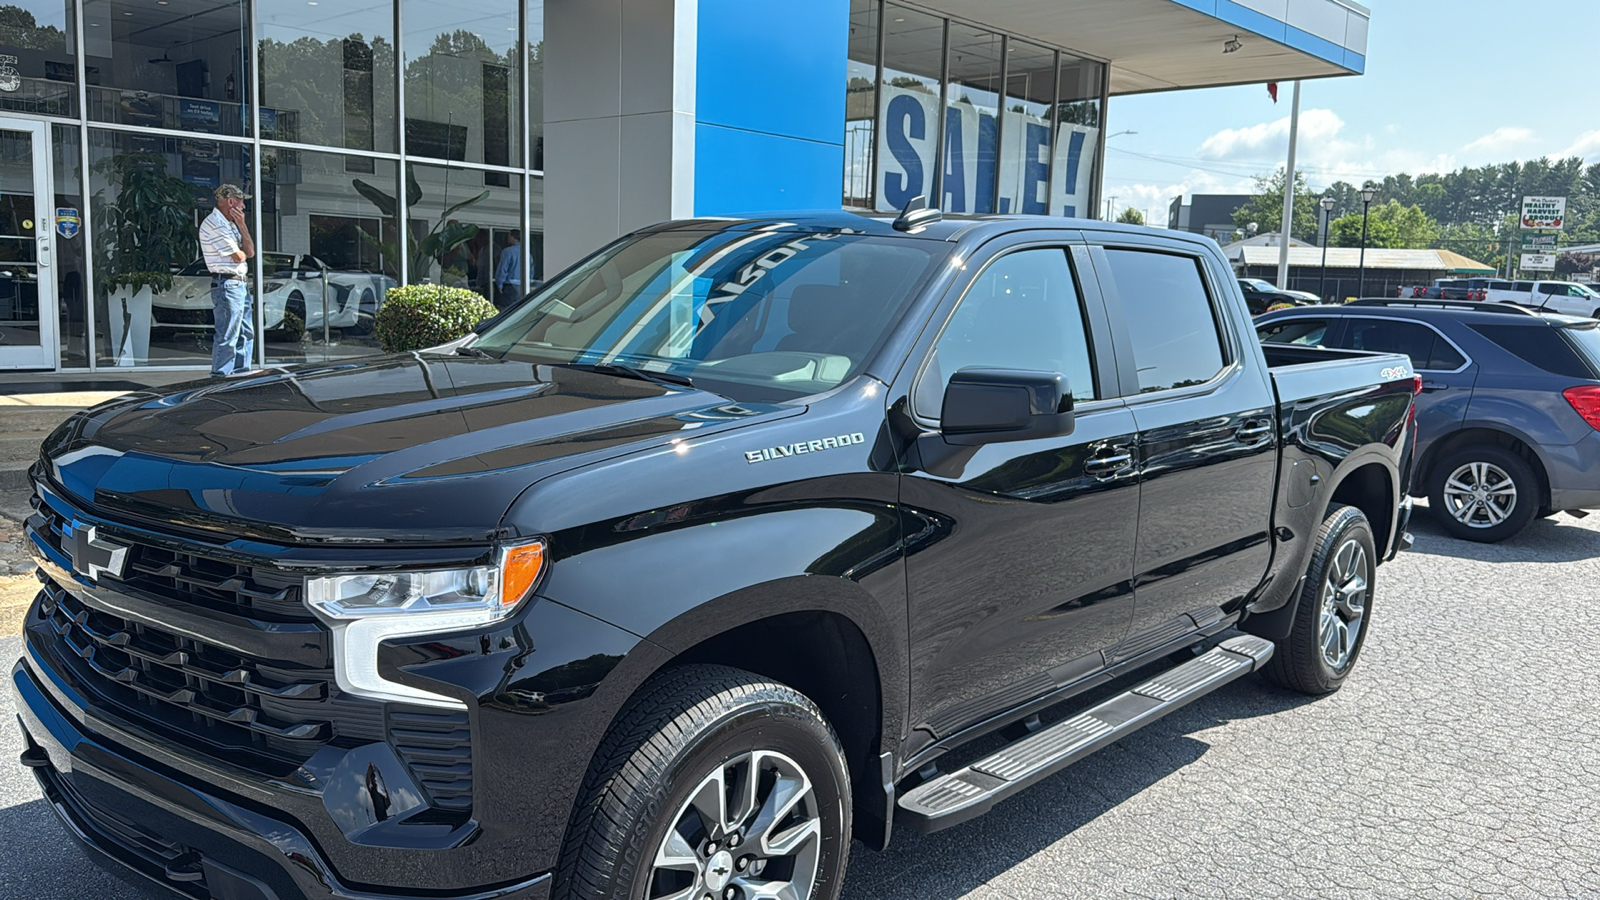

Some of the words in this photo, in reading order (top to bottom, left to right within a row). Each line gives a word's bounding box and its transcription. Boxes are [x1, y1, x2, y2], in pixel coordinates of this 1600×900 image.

[884, 94, 1086, 218] SALE!
[745, 432, 865, 464] SILVERADO
[613, 775, 676, 900] RIDGESTONE
